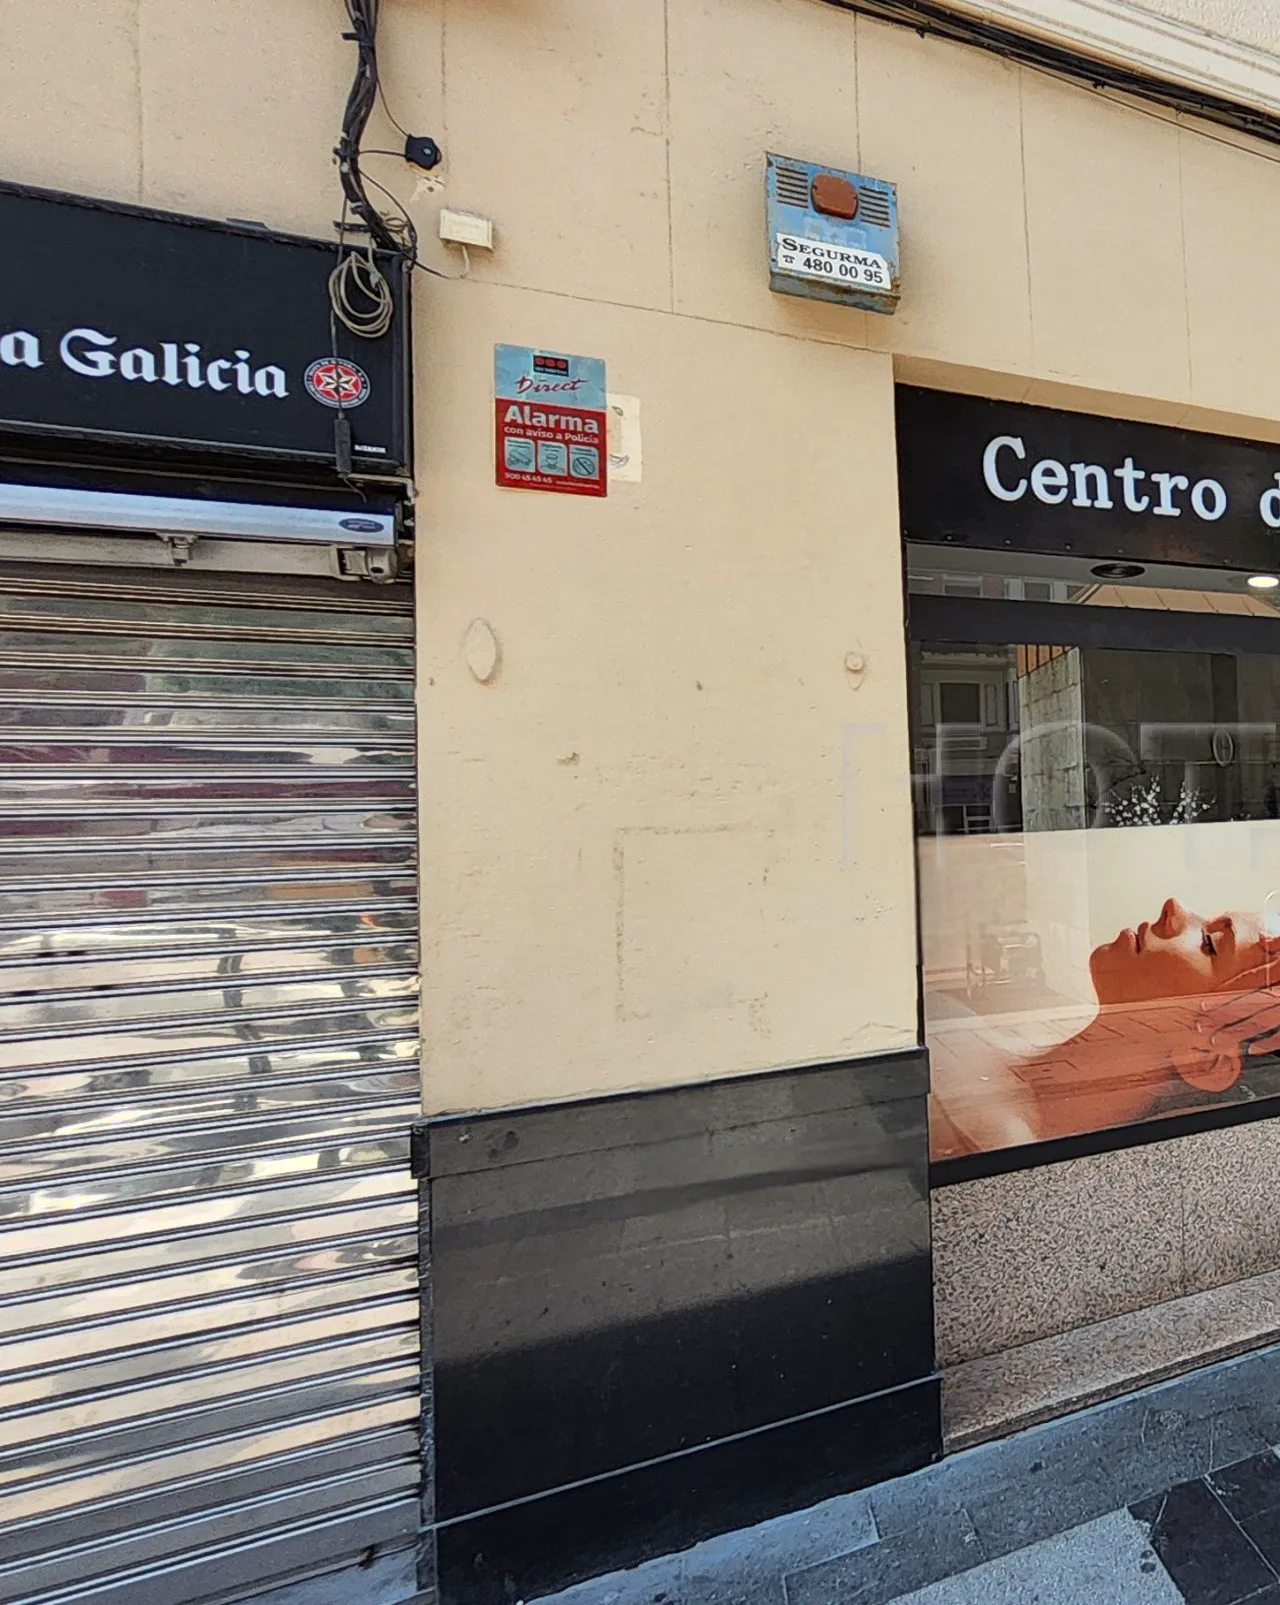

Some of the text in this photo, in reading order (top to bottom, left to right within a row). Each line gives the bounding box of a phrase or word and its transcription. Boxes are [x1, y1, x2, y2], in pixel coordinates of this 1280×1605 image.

[803, 257, 883, 284] 480 00 95
[60, 328, 290, 398] Galicia
[515, 375, 590, 394] Direct
[504, 405, 599, 434] Alarma
[504, 426, 523, 435] con
[526, 428, 554, 439] aviso
[982, 436, 1227, 521] Centro
